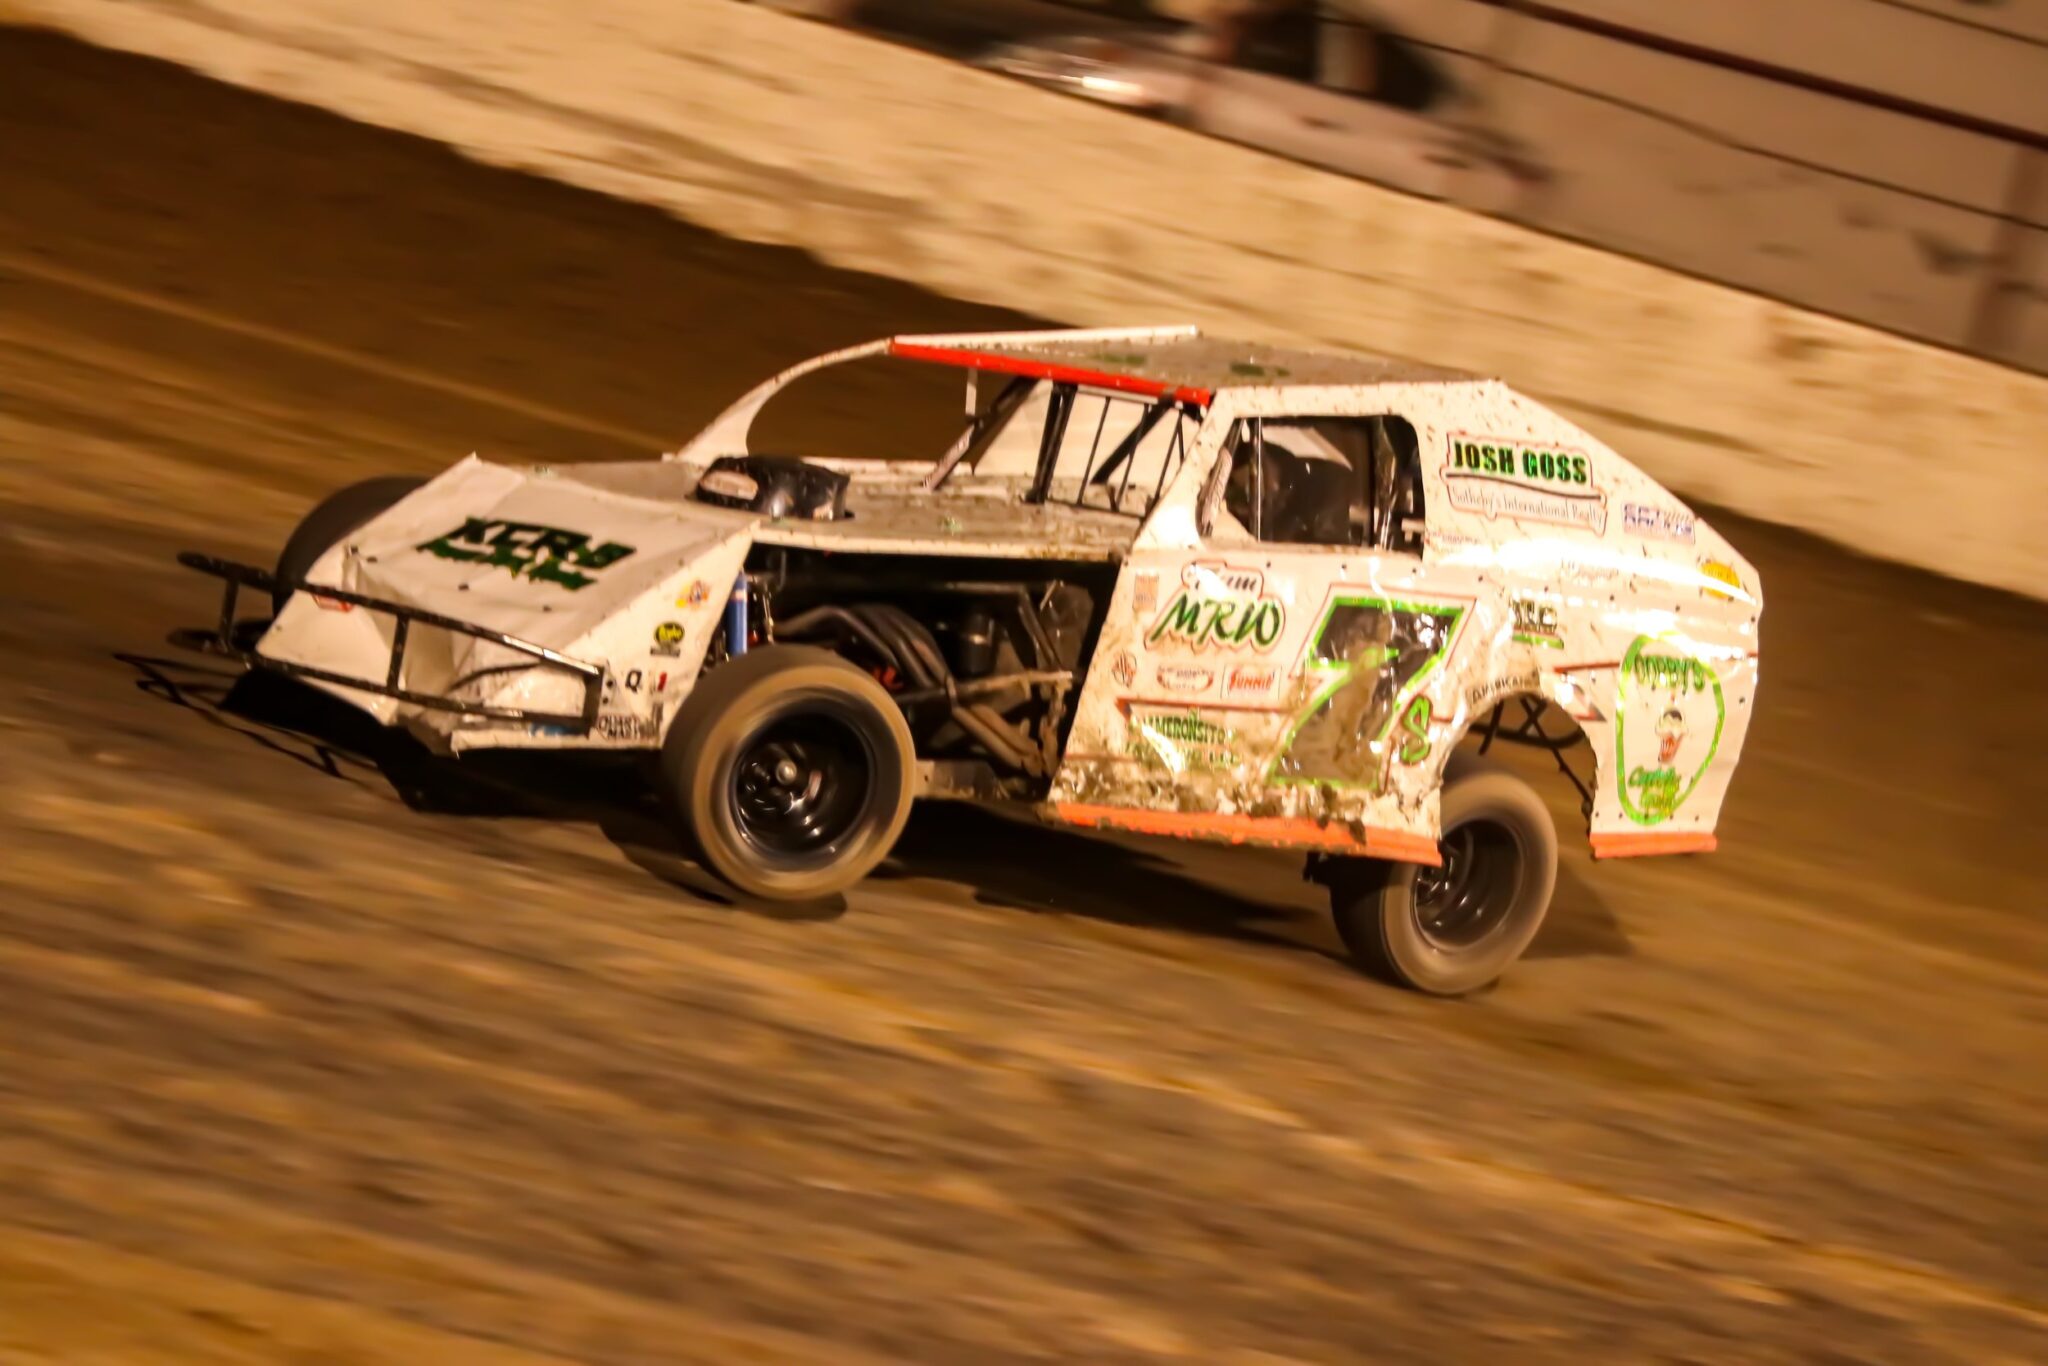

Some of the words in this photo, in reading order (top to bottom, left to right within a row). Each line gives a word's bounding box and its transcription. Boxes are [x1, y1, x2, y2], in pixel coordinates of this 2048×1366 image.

[1454, 440, 1515, 475] JOSH
[1522, 449, 1587, 484] GOSS
[1149, 592, 1281, 647] MRW
